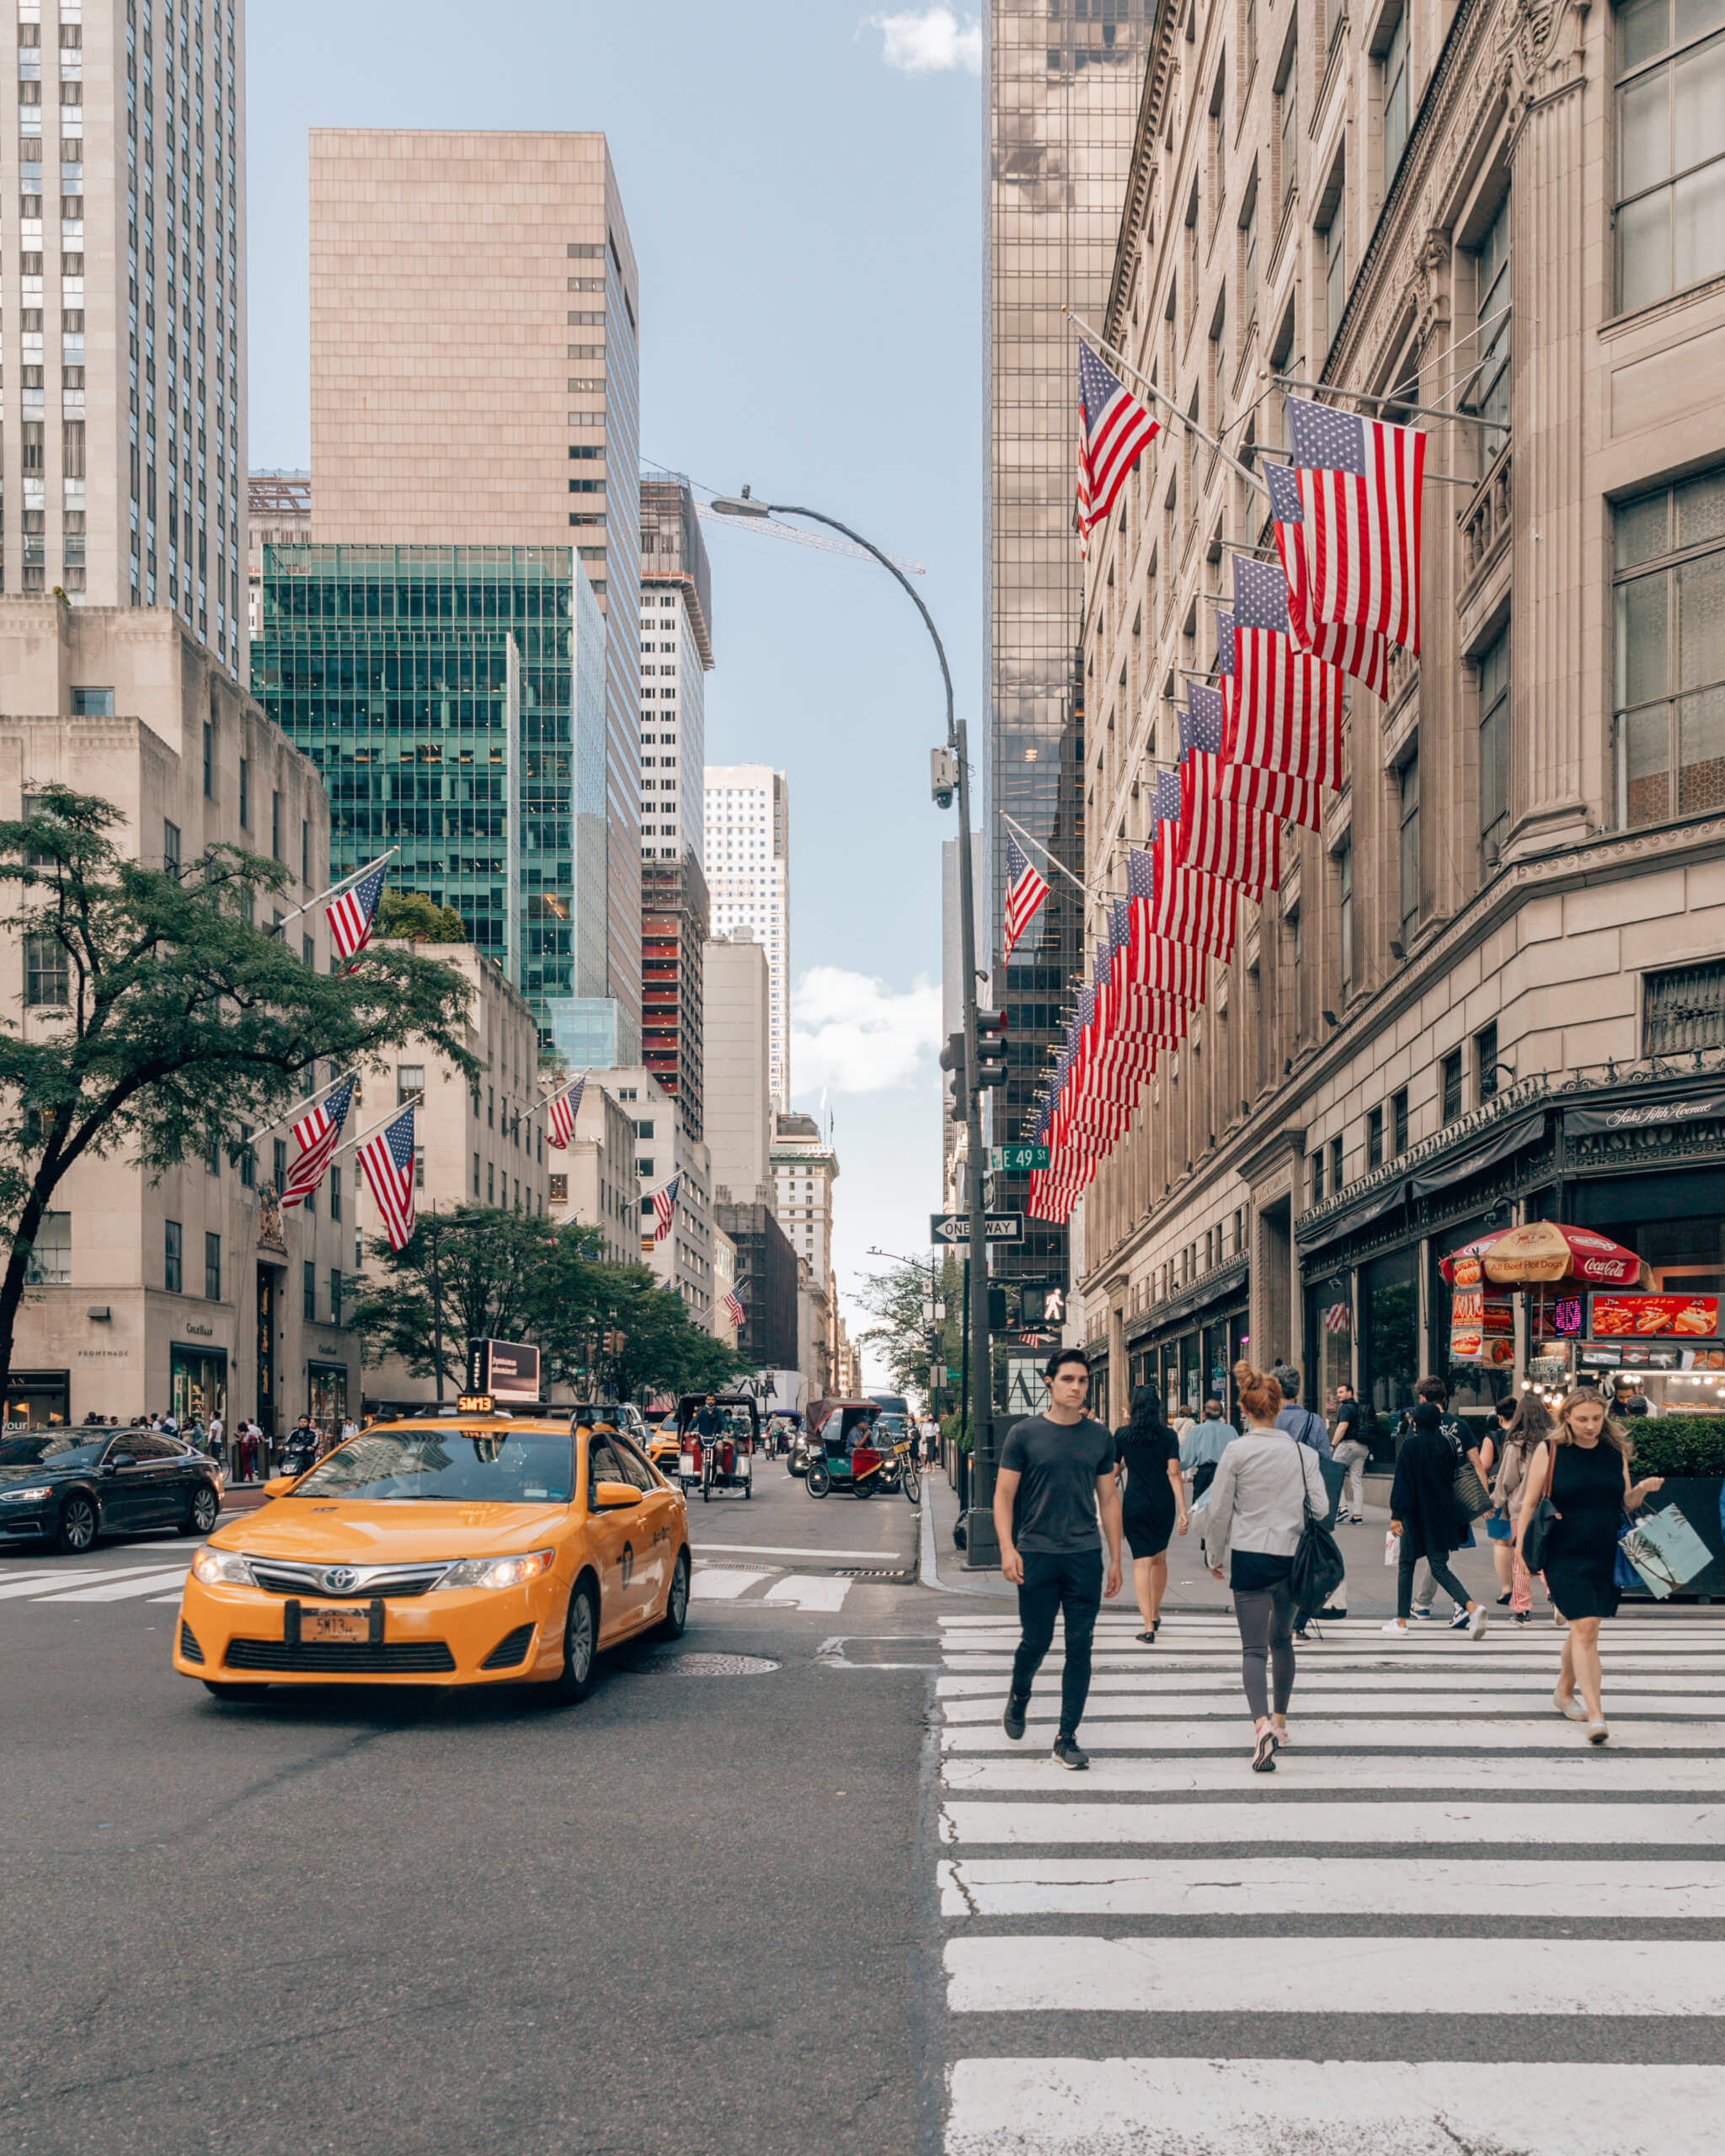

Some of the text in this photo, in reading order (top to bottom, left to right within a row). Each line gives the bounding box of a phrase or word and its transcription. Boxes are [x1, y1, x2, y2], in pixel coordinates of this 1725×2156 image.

[1606, 1102, 1712, 1127] Saks Fifth Avenue
[1003, 1150, 1046, 1167] E 49 St
[945, 1222, 1011, 1235] ONE WAY
[1491, 1259, 1564, 1272] All Beef Hot Dogs
[458, 1396, 492, 1411] 5M13
